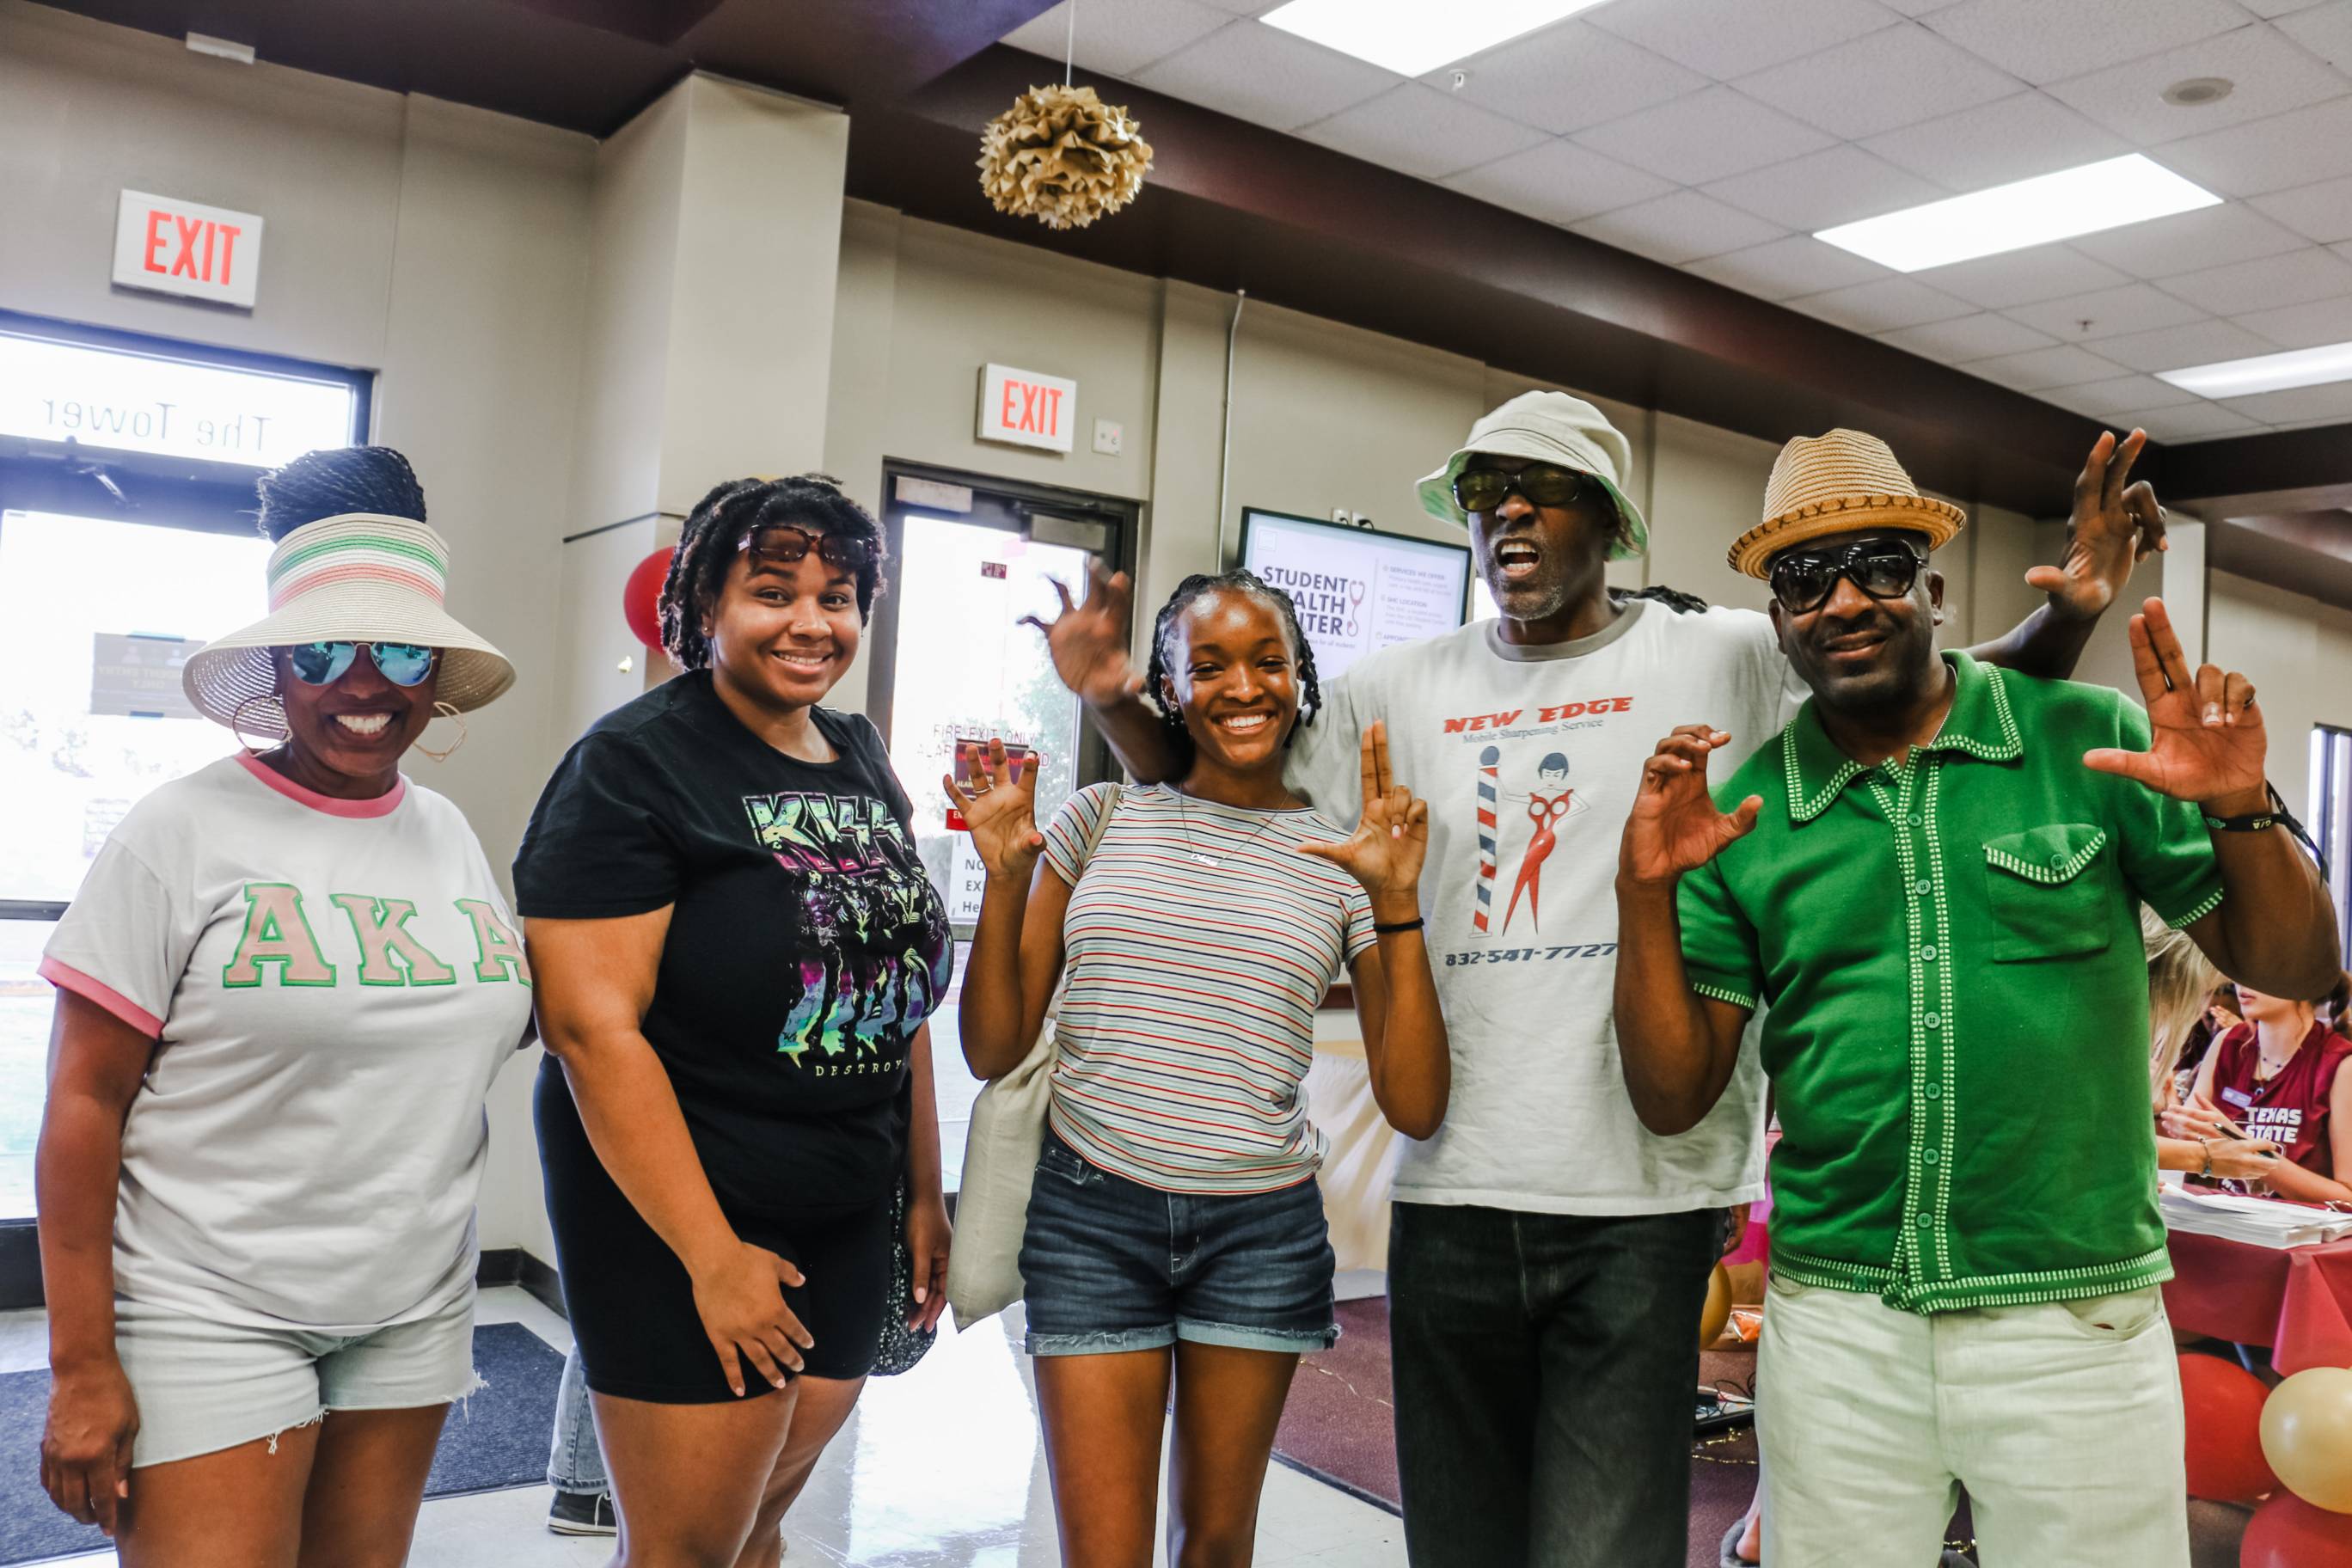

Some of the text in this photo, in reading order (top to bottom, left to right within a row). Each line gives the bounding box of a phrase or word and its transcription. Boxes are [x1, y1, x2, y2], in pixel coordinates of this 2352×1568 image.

[144, 210, 241, 285] EXIT
[1001, 379, 1063, 437] EXIT
[1264, 566, 1349, 594] STUDENT
[1292, 590, 1346, 616] ALTH
[1298, 611, 1343, 636] TER
[1443, 696, 1634, 734] NEW EDGE
[1463, 719, 1603, 744] Mobile Sharpening Service
[962, 900, 980, 913] He
[1445, 942, 1619, 967] 832-541-7727
[815, 1059, 903, 1077] DESTROY
[2244, 1106, 2303, 1126] TEXAS
[2245, 1124, 2299, 1144] STATE
